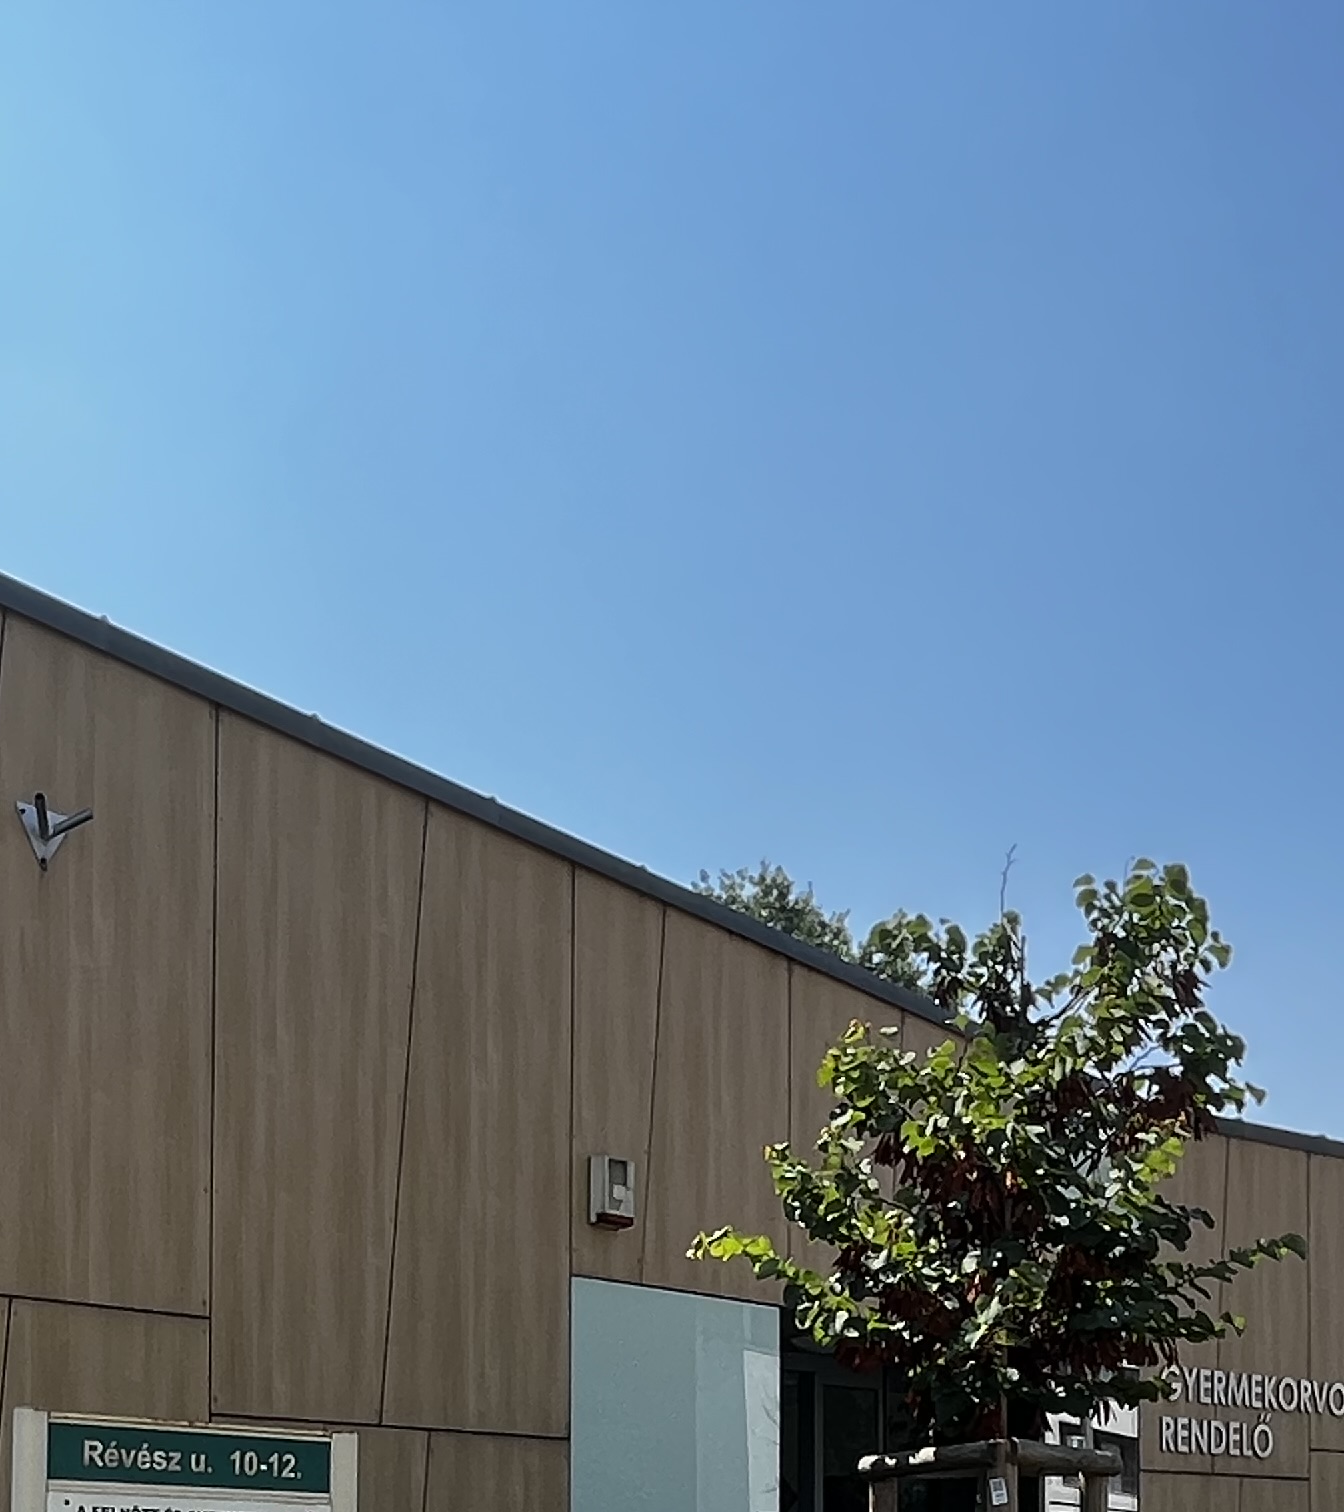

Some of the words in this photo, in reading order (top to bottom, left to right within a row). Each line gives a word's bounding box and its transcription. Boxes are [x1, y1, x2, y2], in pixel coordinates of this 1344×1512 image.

[1160, 1412, 1274, 1459] RENDELŐ
[83, 1440, 182, 1473] Révész
[190, 1453, 213, 1474] u.
